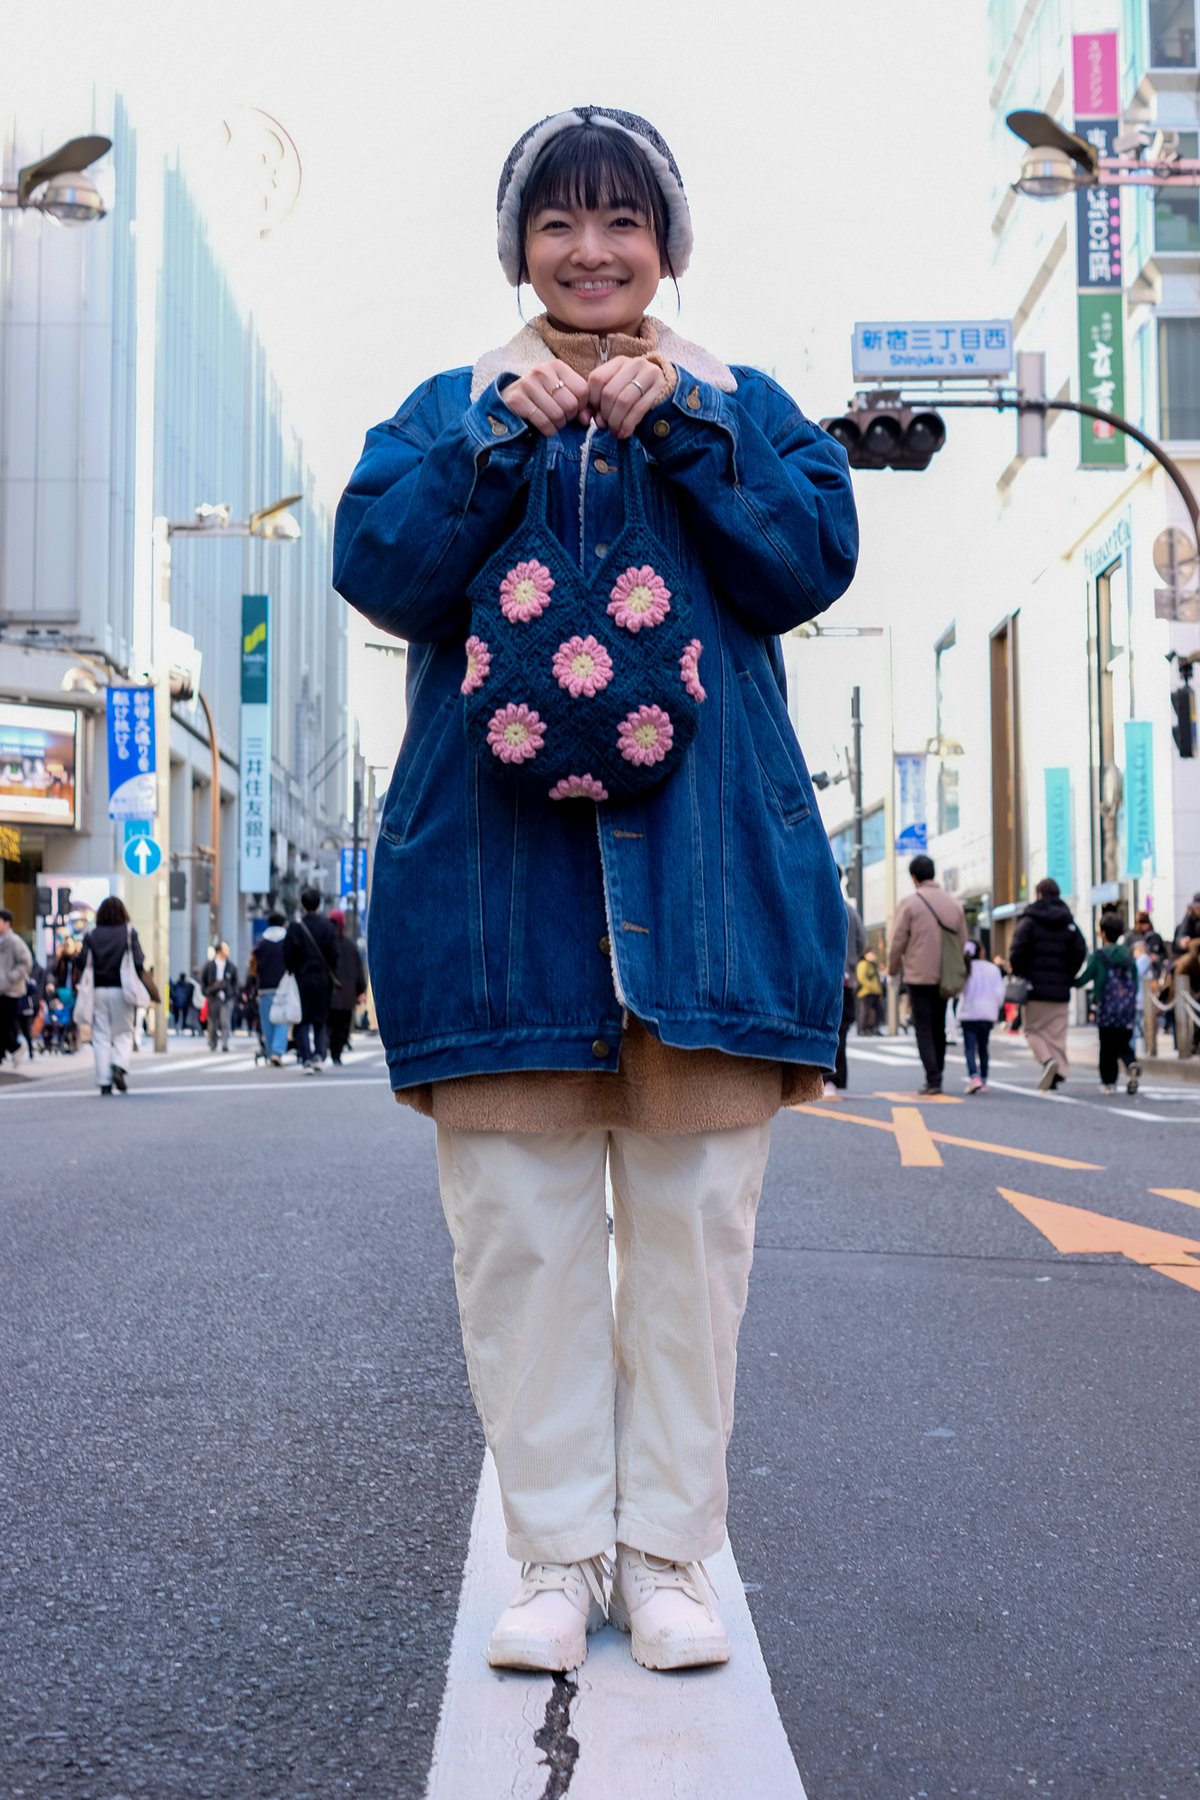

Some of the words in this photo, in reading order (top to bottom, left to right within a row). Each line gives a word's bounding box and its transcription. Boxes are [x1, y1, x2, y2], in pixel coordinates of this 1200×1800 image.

[862, 328, 1006, 350] 新宿三丁目西
[890, 353, 944, 366] Shinjuku
[950, 353, 957, 364] 3
[245, 737, 263, 858] 三井住友銀行
